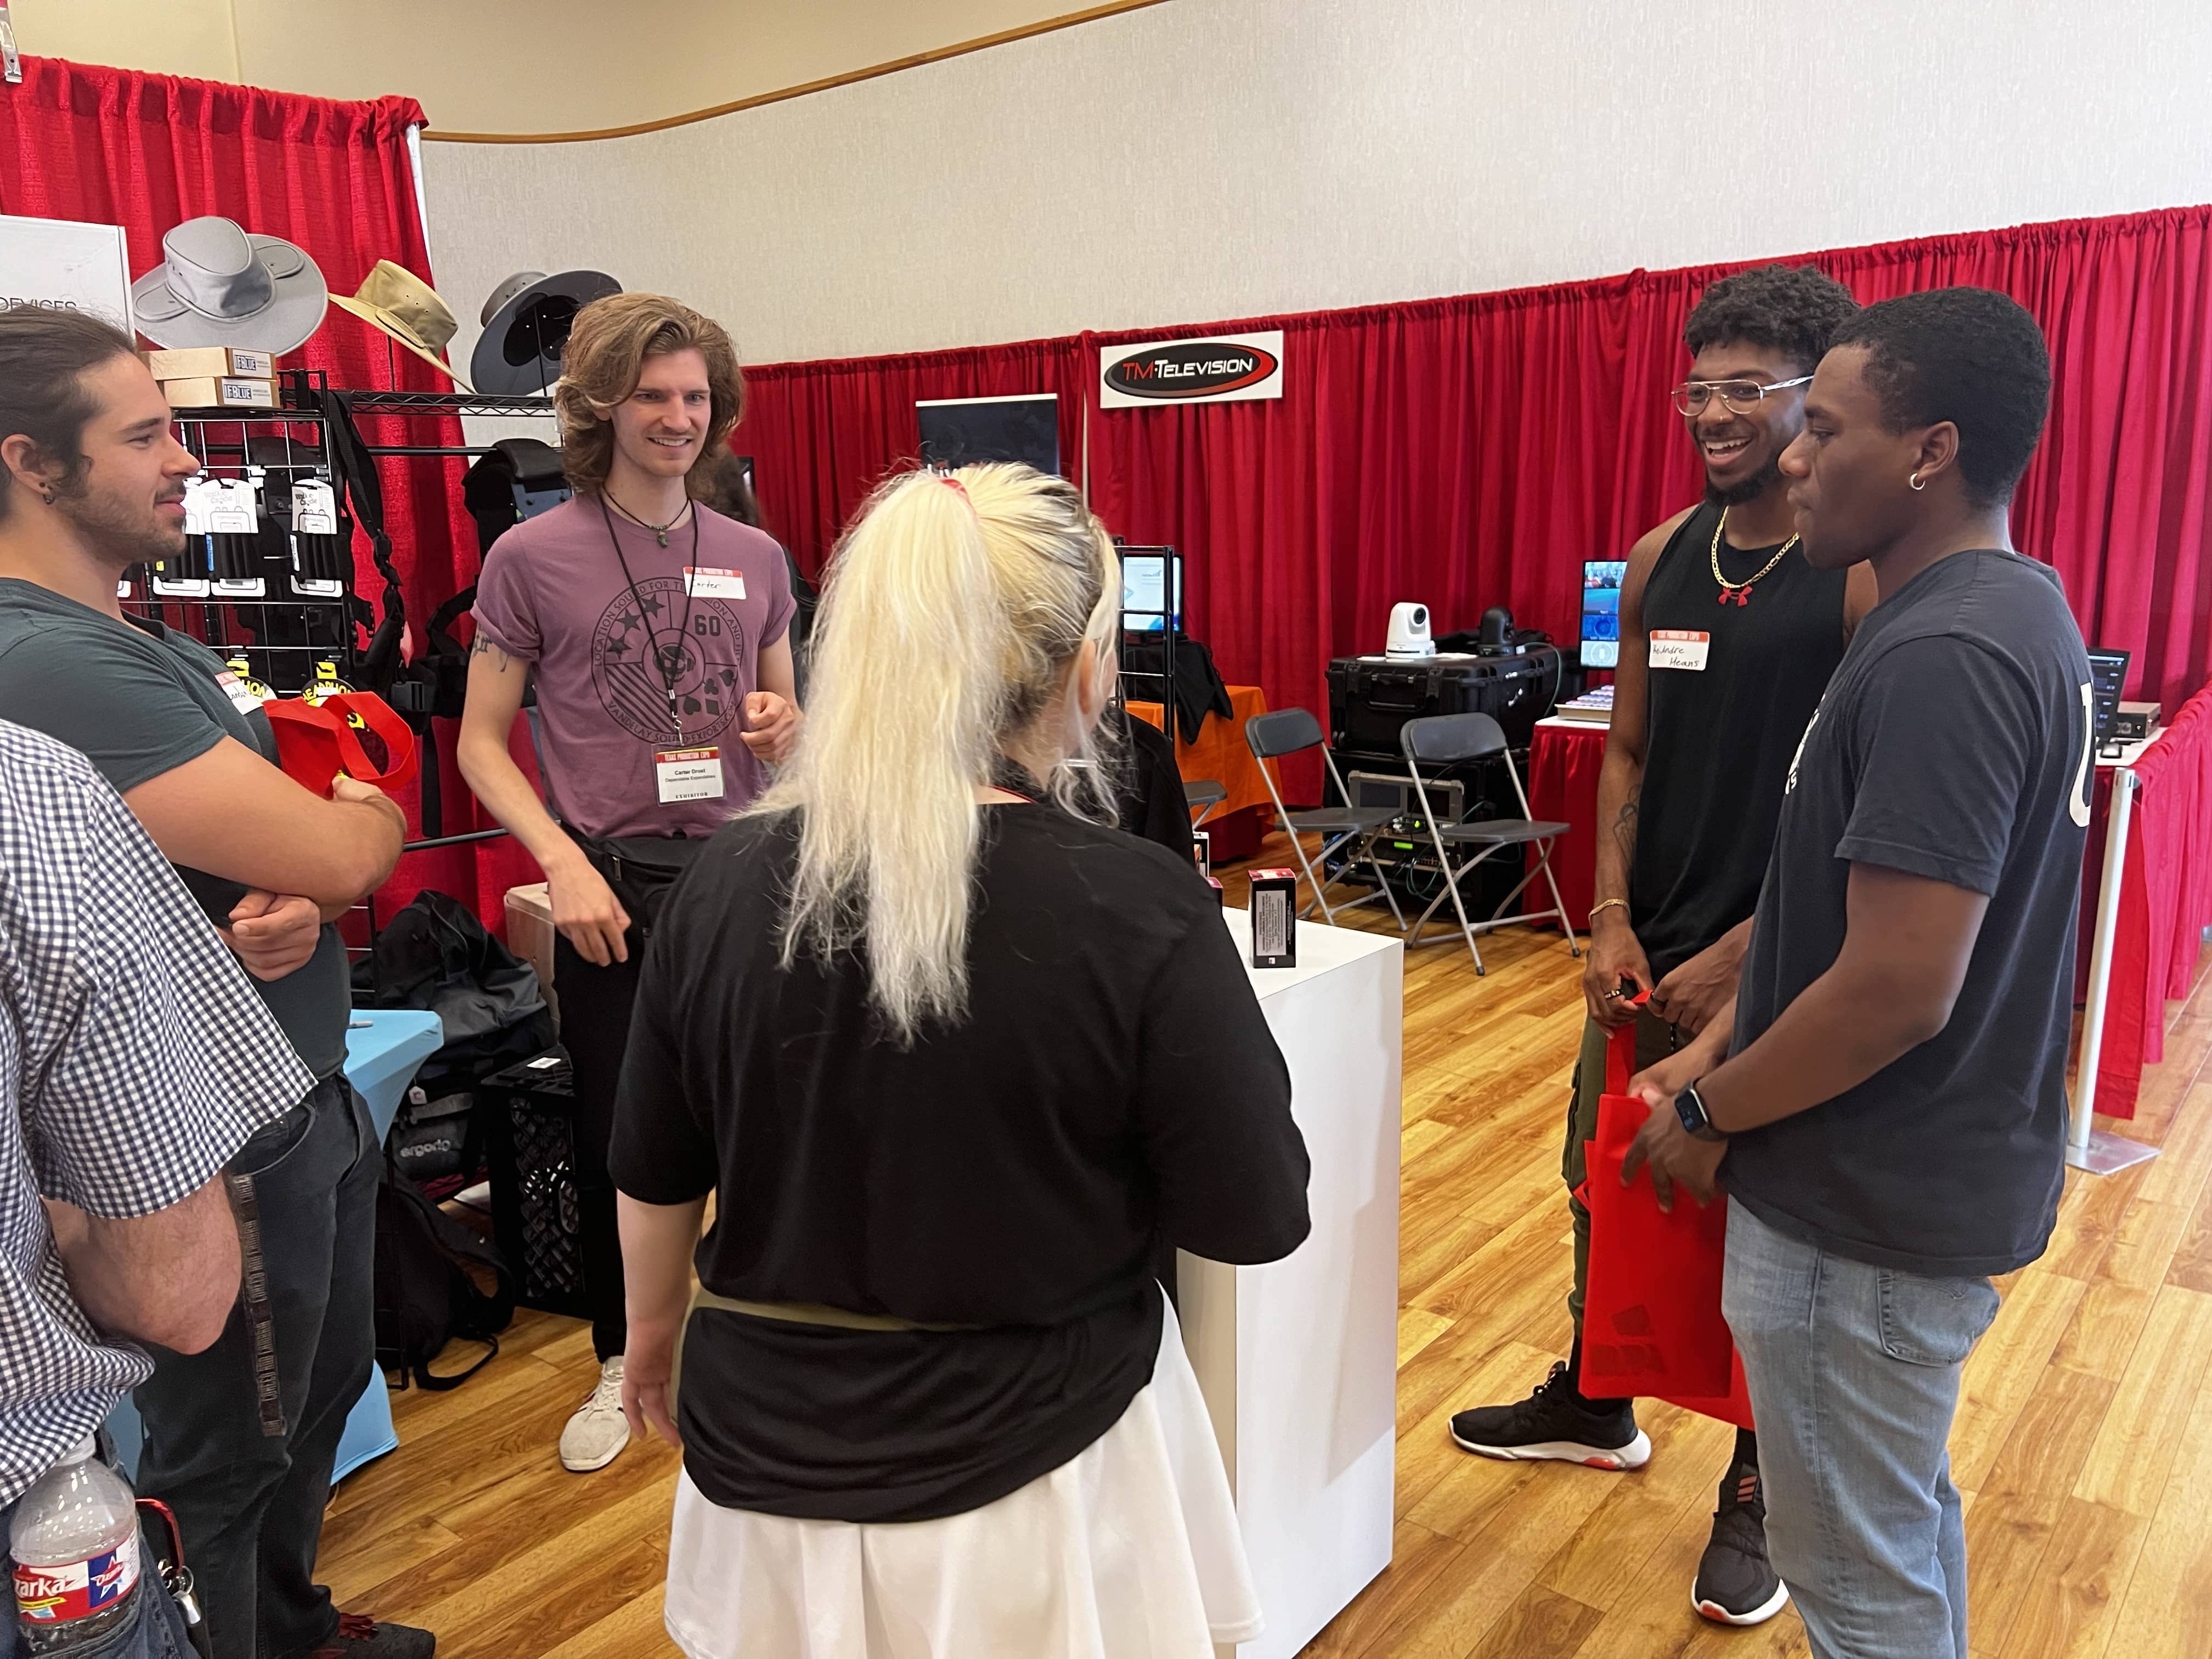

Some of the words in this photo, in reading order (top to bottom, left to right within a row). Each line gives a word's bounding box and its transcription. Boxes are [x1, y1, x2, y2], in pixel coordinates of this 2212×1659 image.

[235, 354, 256, 370] IFBLUE
[224, 384, 252, 399] IFBLUE
[595, 613, 615, 666] LOCATION
[650, 581, 669, 591] FOR
[727, 619, 741, 640] AND
[695, 614, 721, 636] 60
[608, 701, 652, 738] VANDELAY
